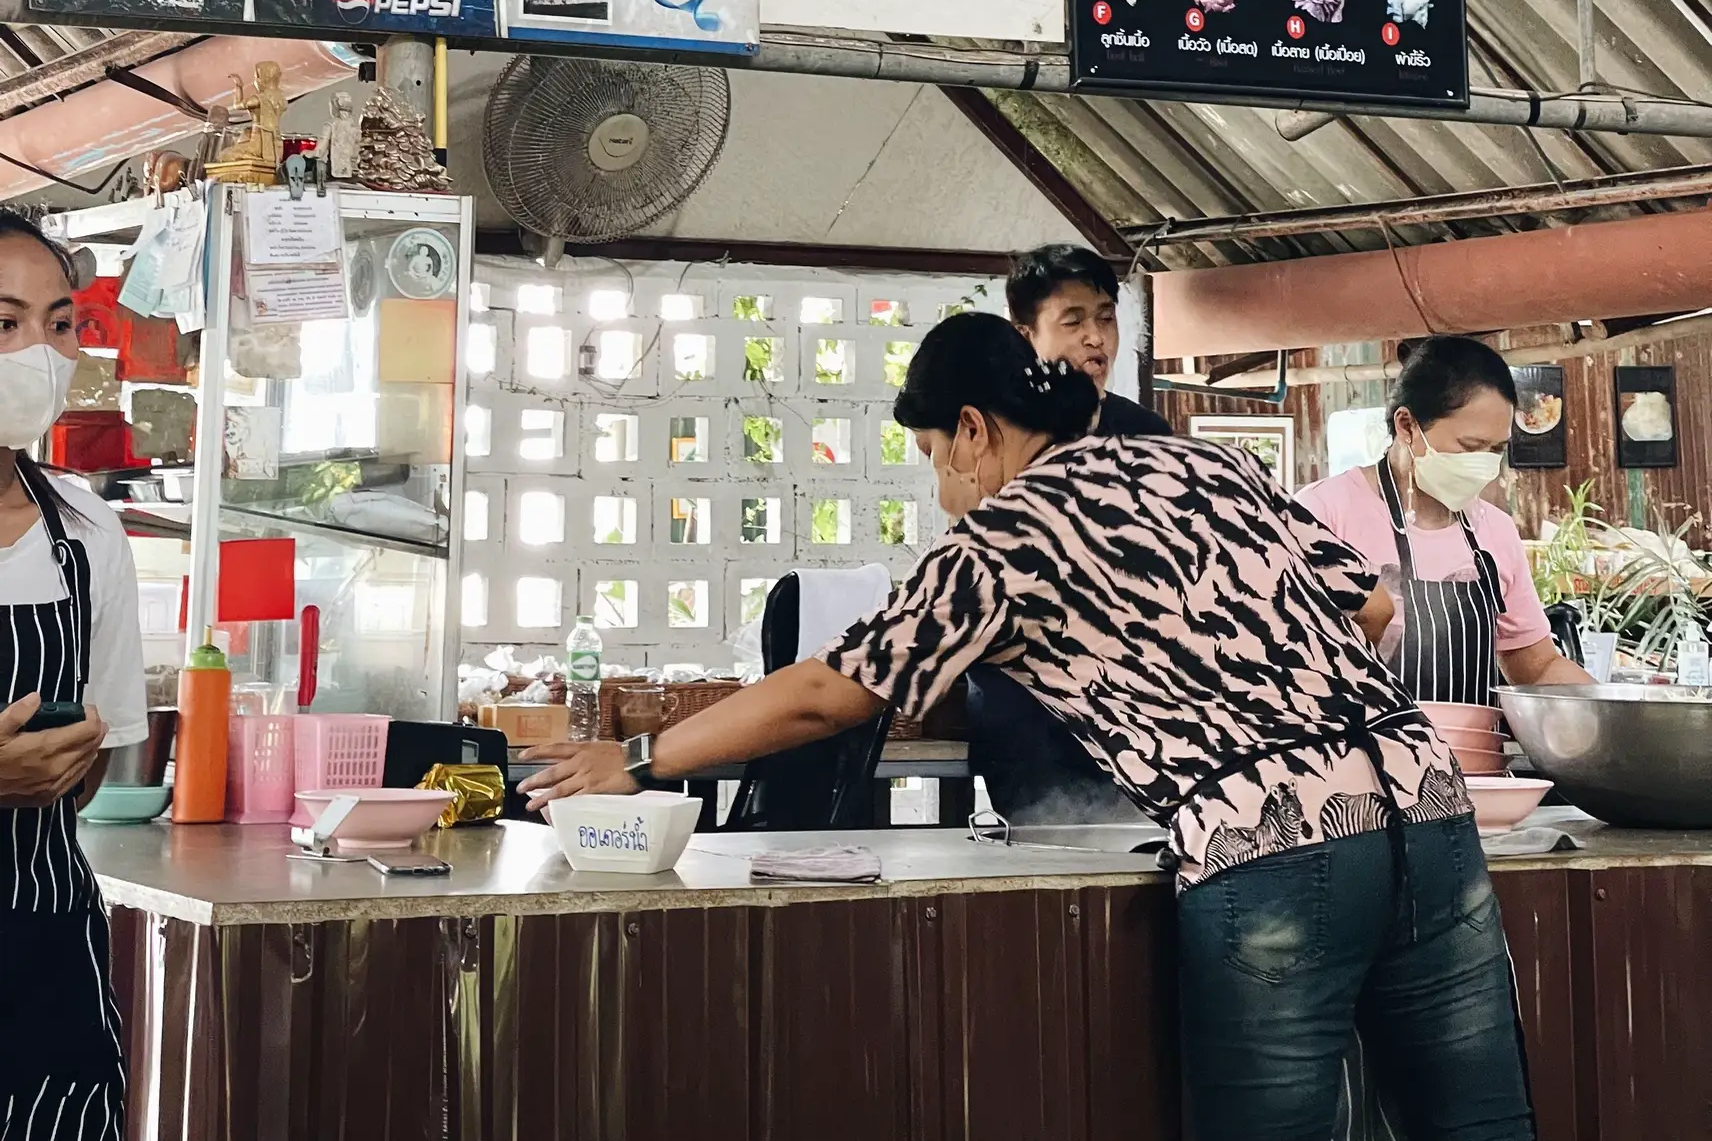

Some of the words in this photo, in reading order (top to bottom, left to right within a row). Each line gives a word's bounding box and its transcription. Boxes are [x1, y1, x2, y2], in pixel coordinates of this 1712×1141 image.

[1097, 5, 1107, 18] F
[1188, 11, 1200, 26] G
[1290, 20, 1300, 34] H
[1100, 27, 1151, 50] ลูกชิ้นเนื้อ
[1177, 32, 1212, 52] เนื้อวัว
[1216, 35, 1259, 58] (เนื้อสด)
